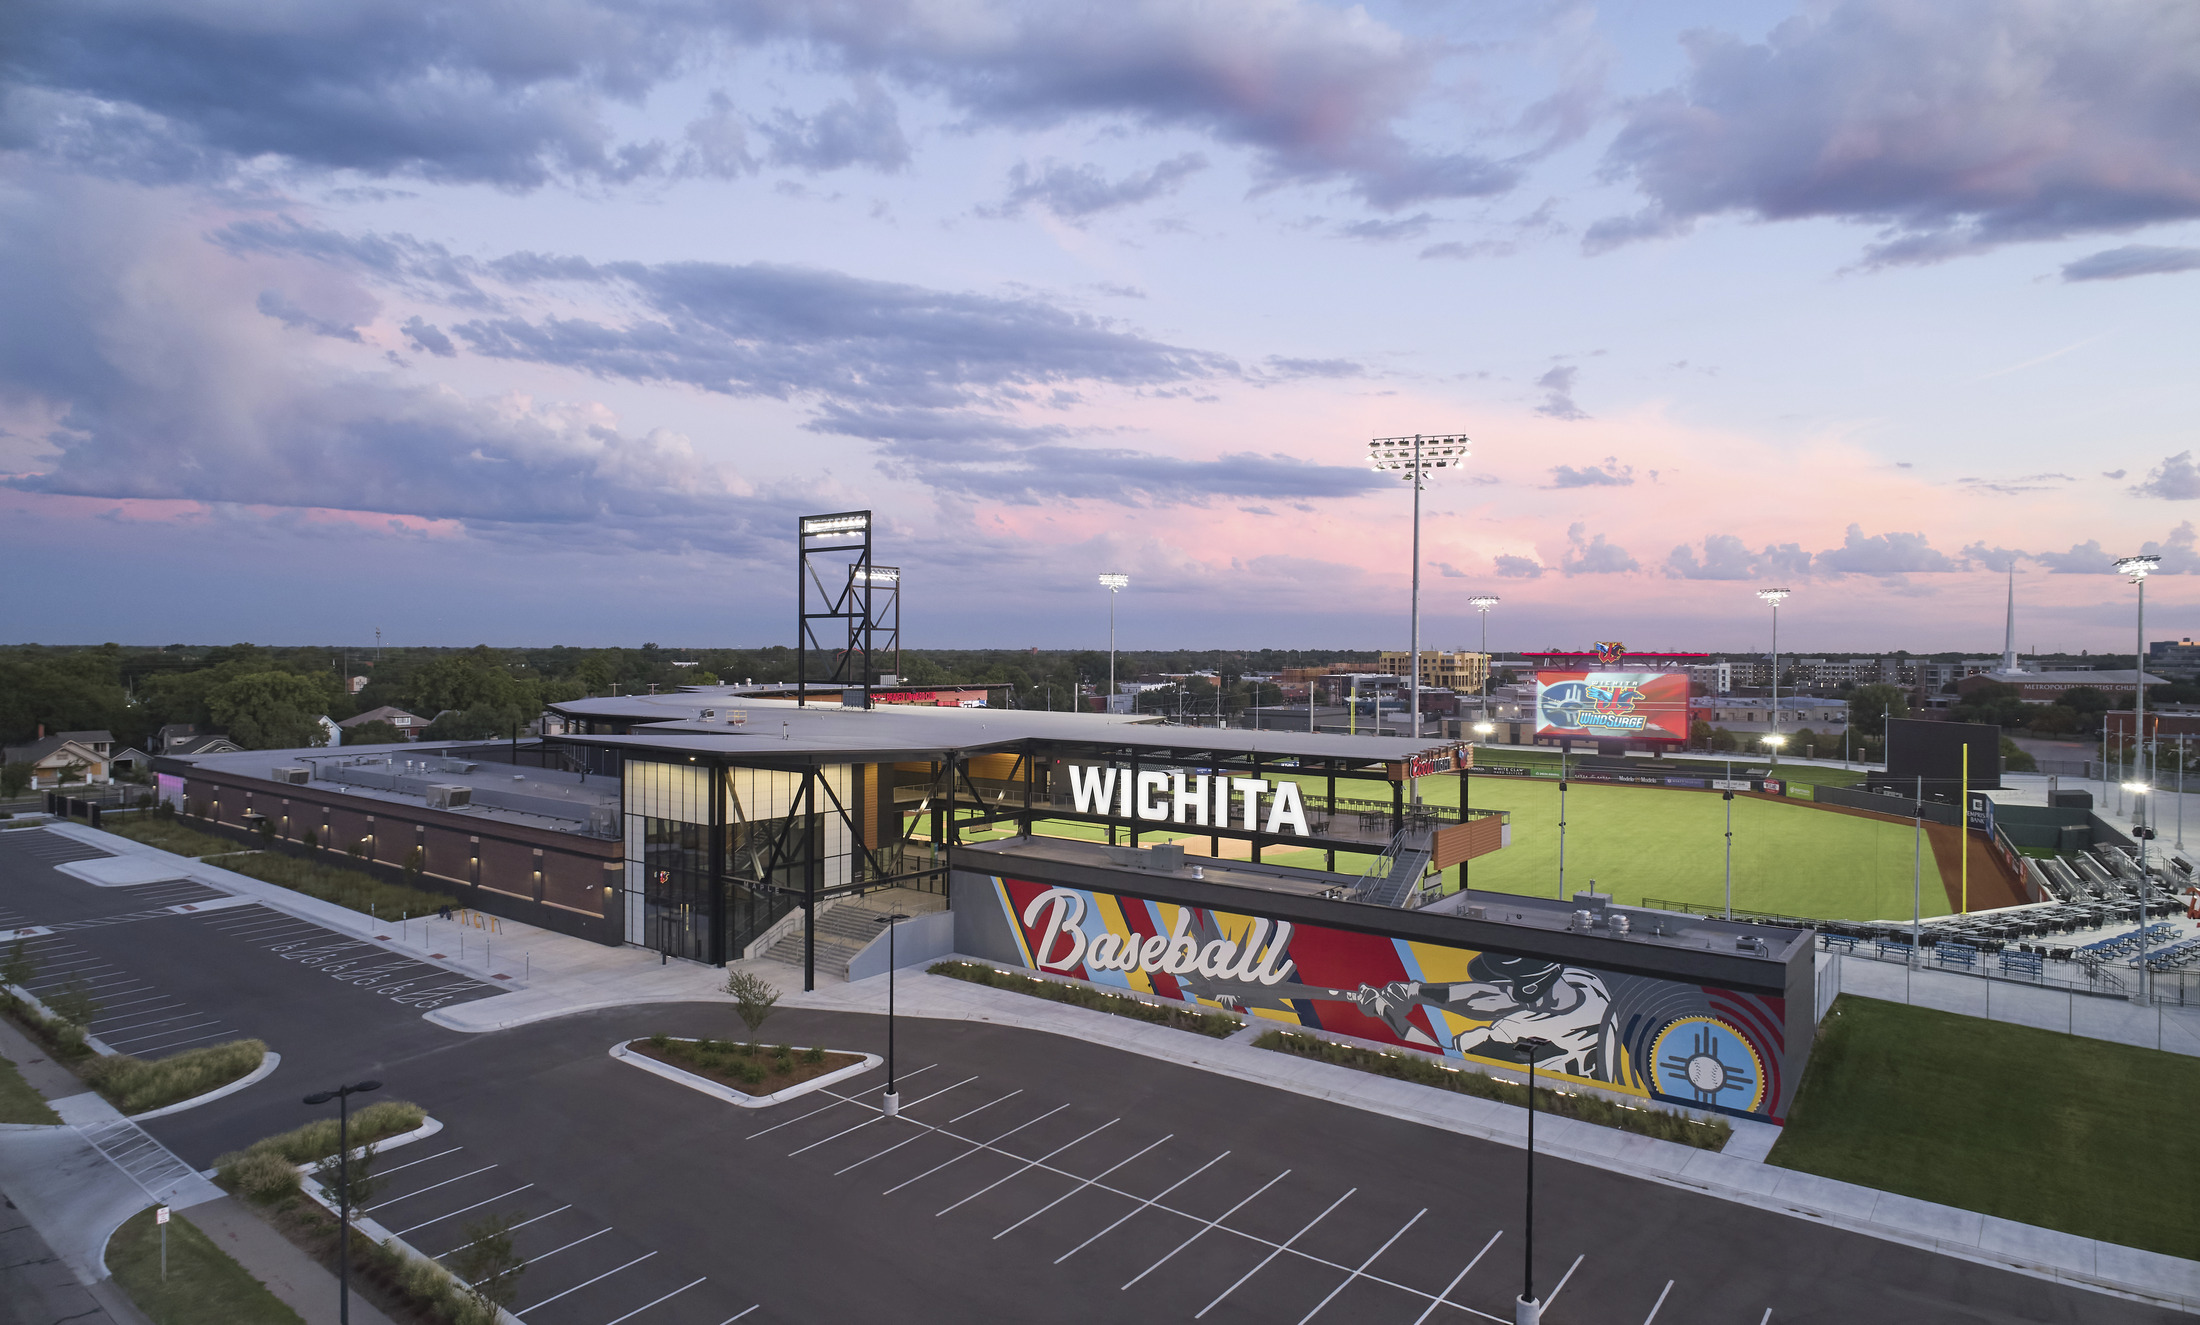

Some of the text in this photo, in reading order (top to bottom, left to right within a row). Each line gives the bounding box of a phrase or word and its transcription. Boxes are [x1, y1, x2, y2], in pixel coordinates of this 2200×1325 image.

[1410, 755, 1434, 777] Coors
[1068, 764, 1310, 837] WICHITA
[1967, 810, 1986, 818] EMPRIS
[1970, 816, 1985, 824] BANK
[743, 881, 780, 894] MAPLE
[1023, 887, 1295, 986] Baseball
